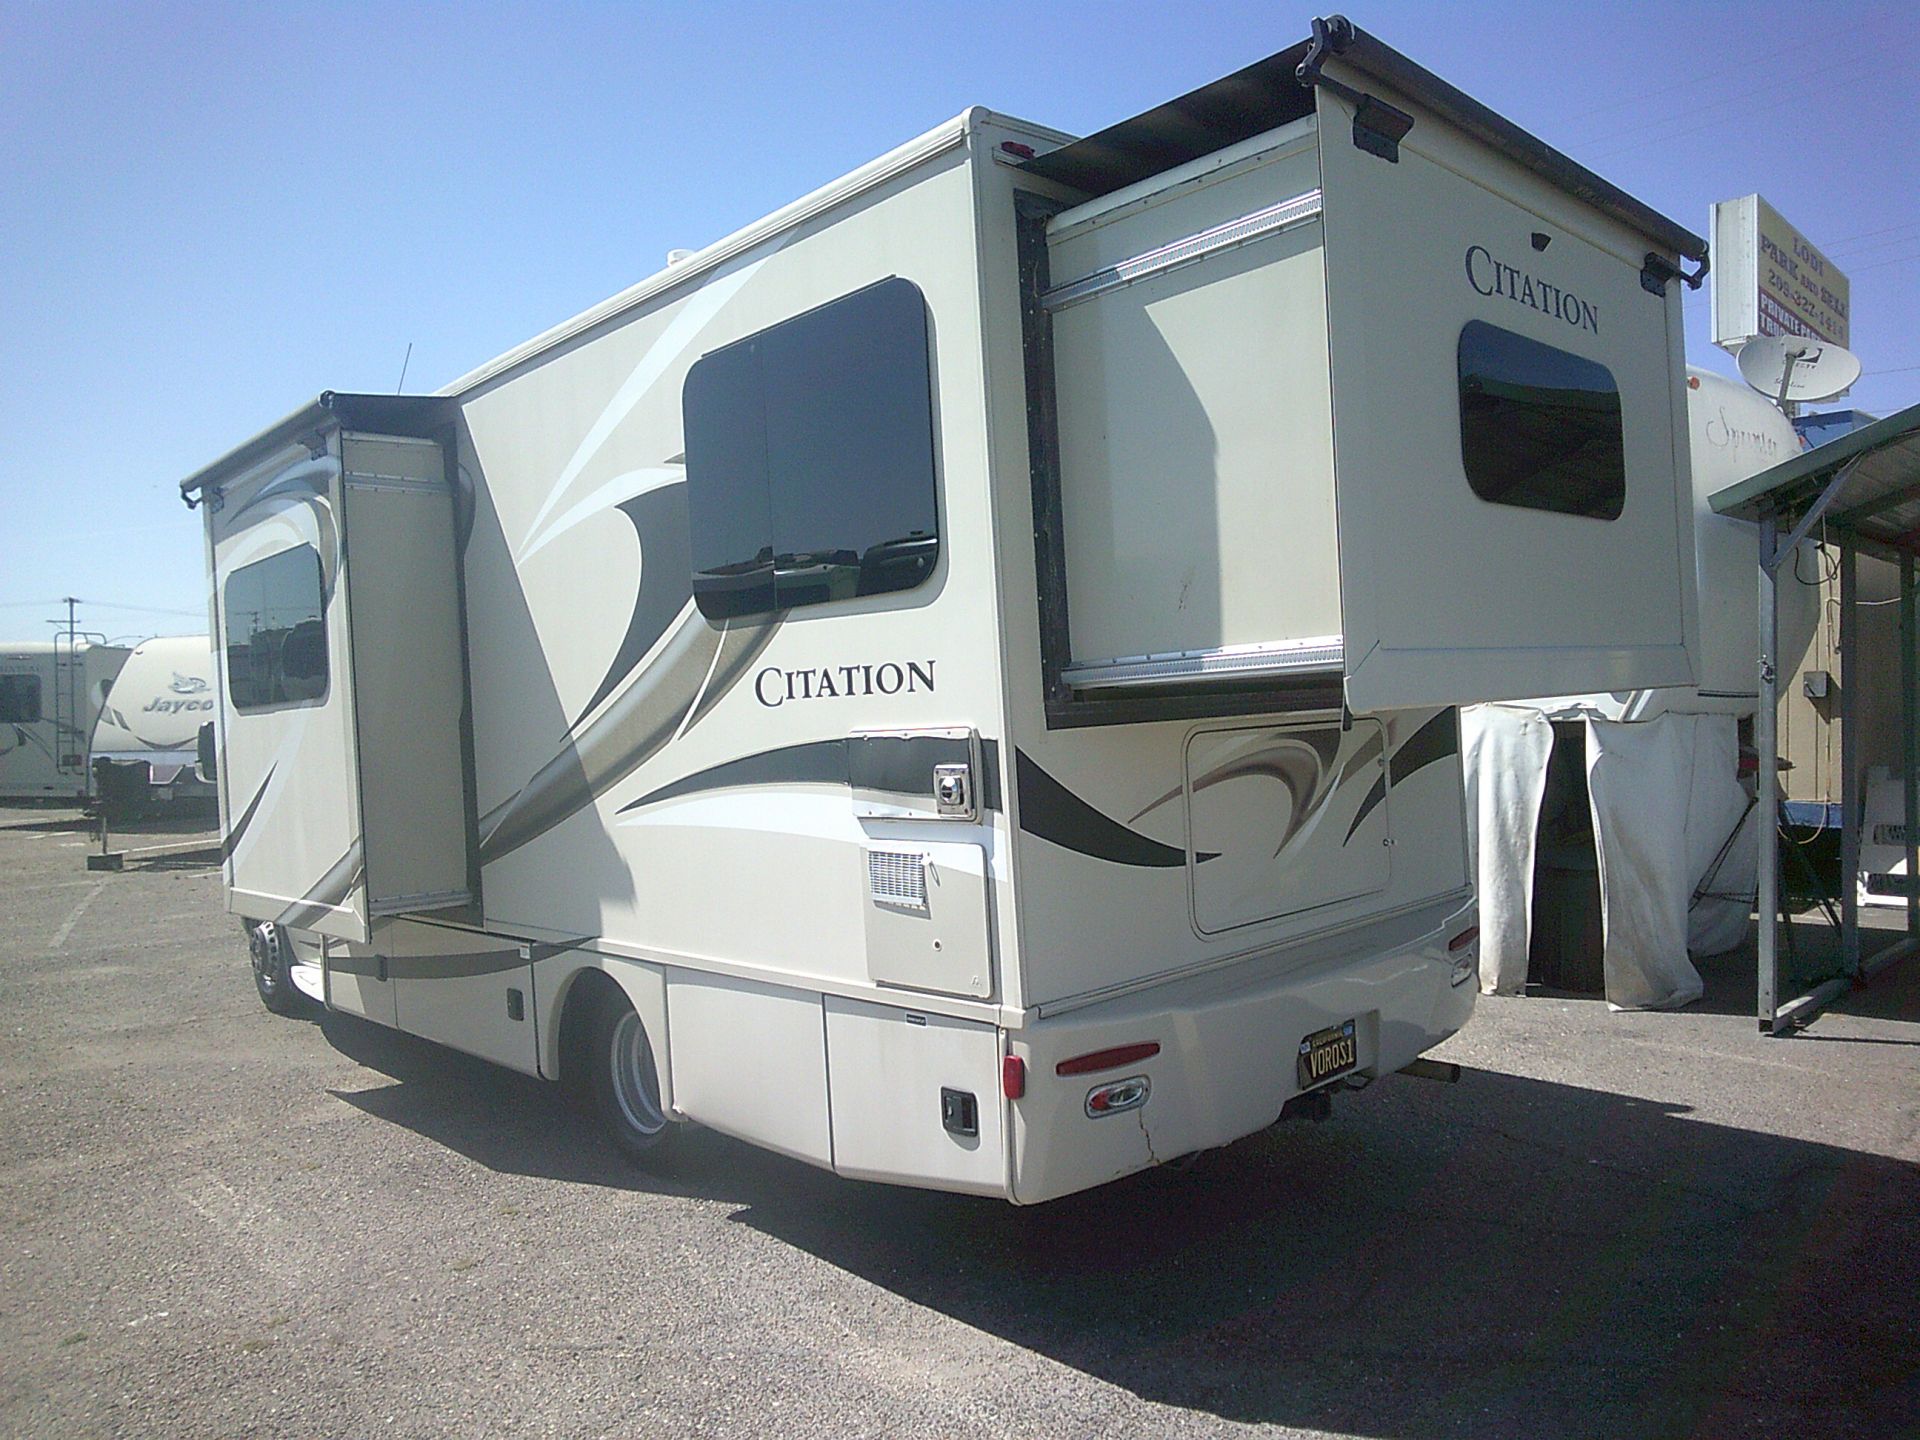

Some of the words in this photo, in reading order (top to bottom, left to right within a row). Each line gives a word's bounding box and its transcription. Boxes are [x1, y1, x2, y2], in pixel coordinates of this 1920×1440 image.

[1760, 234, 1798, 281] PARK
[1793, 236, 1824, 278] LODI
[1465, 245, 1599, 335] CITATION
[1759, 292, 1801, 335] PRIVATE
[754, 659, 936, 708] CITATION
[142, 697, 214, 716] Jayco
